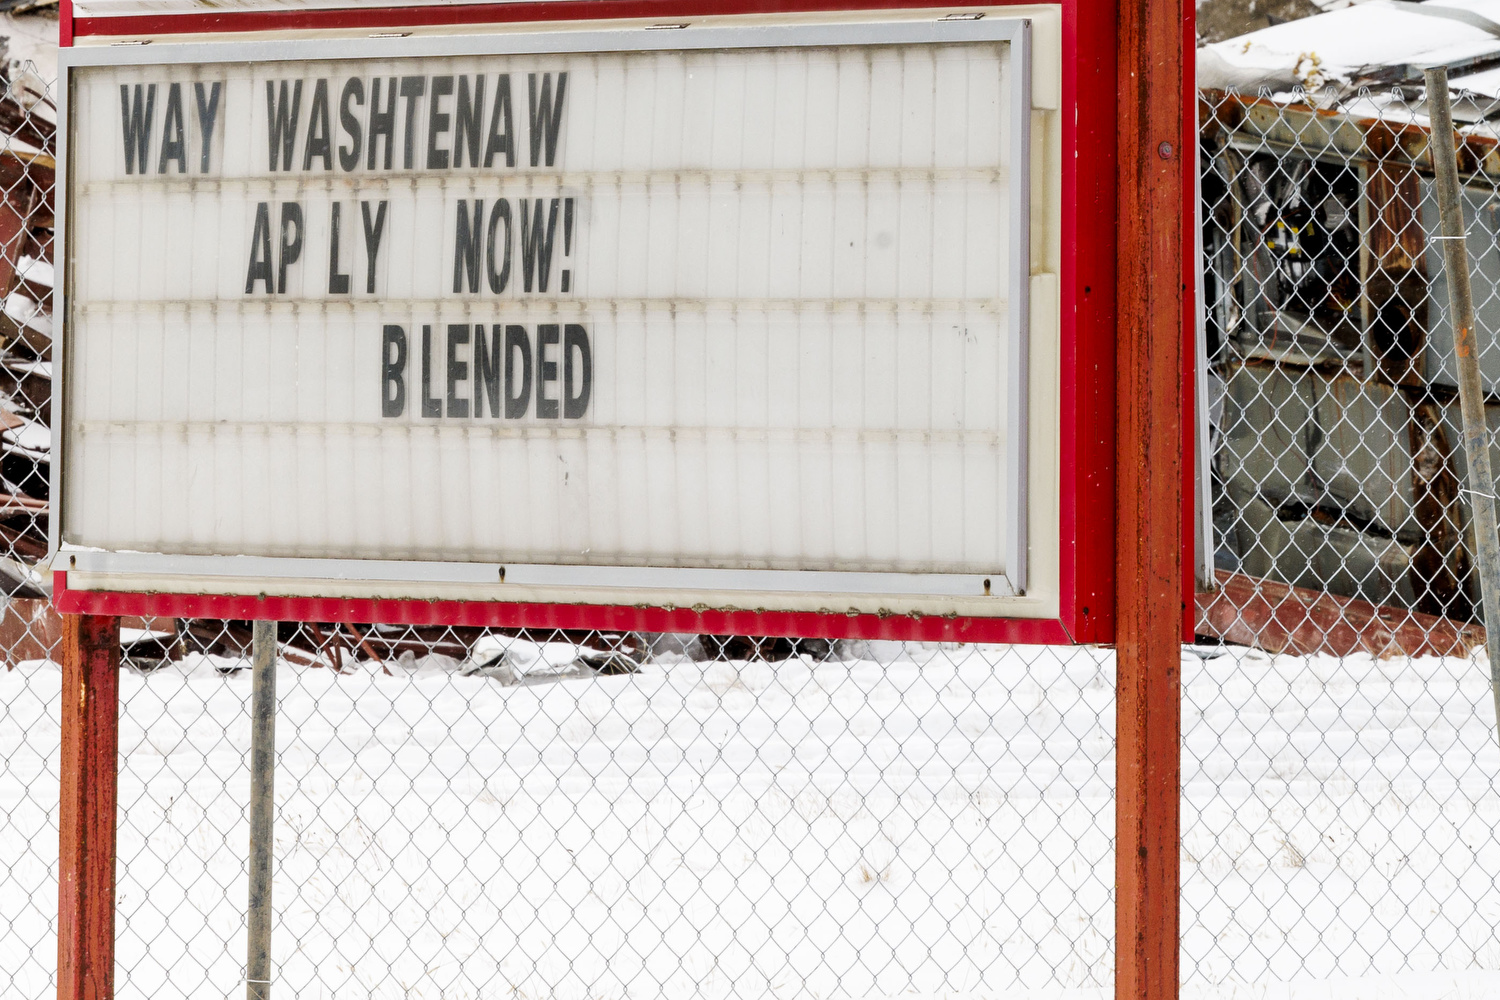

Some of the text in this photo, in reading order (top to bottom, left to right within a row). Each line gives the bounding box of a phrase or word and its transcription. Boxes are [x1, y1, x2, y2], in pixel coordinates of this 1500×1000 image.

[119, 71, 569, 175] WAY WASHTENAW
[452, 197, 576, 294] NOW!
[381, 323, 593, 420] BLENDED
